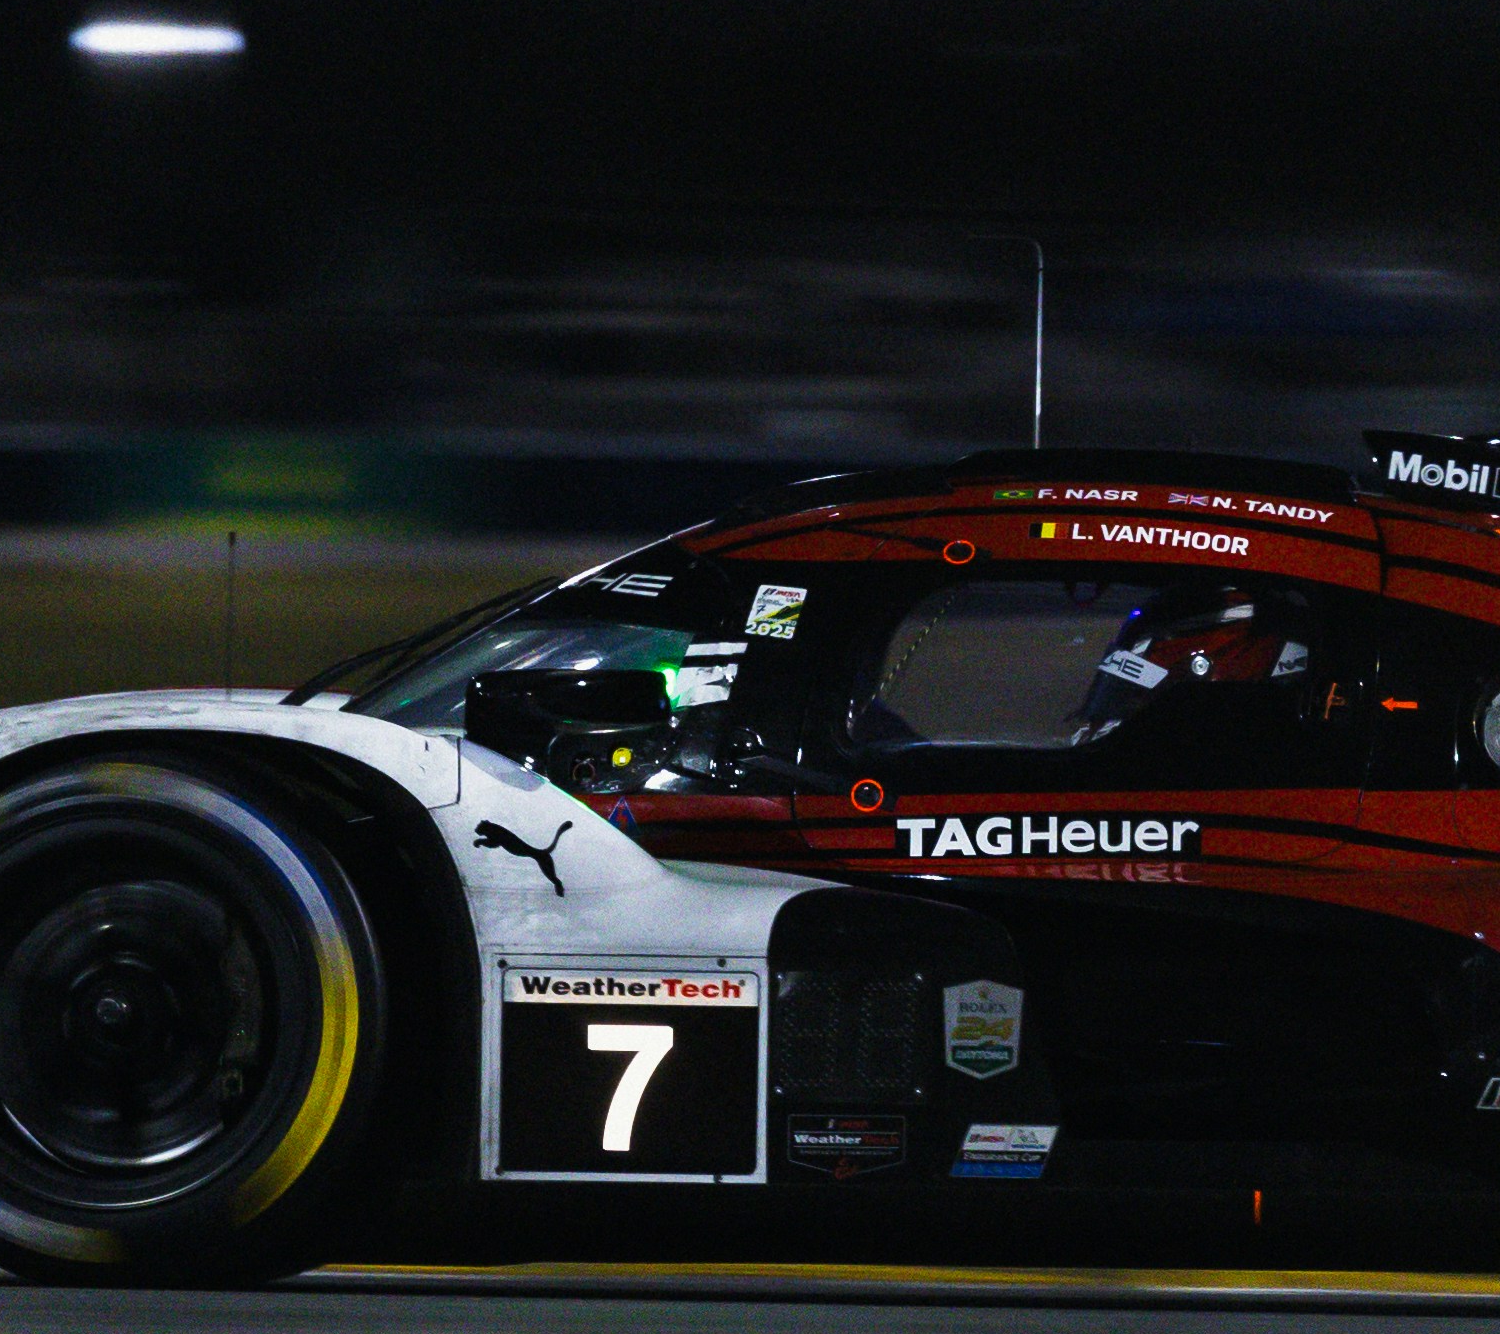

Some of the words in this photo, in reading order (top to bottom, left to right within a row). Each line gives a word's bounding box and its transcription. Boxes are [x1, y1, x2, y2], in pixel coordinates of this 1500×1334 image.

[1388, 450, 1490, 495] Mobil
[1037, 488, 1058, 500] F.
[1065, 488, 1139, 502] NASR
[1211, 496, 1238, 510] N.
[1244, 499, 1334, 524] TANDY
[1071, 522, 1094, 540] L.
[1100, 524, 1250, 556] VANTHOOR
[744, 622, 796, 640] 2025
[521, 976, 742, 999] WeatherTech
[960, 1002, 1008, 1014] ROLEX
[952, 1016, 1016, 1041] 24
[587, 1024, 674, 1152] 7
